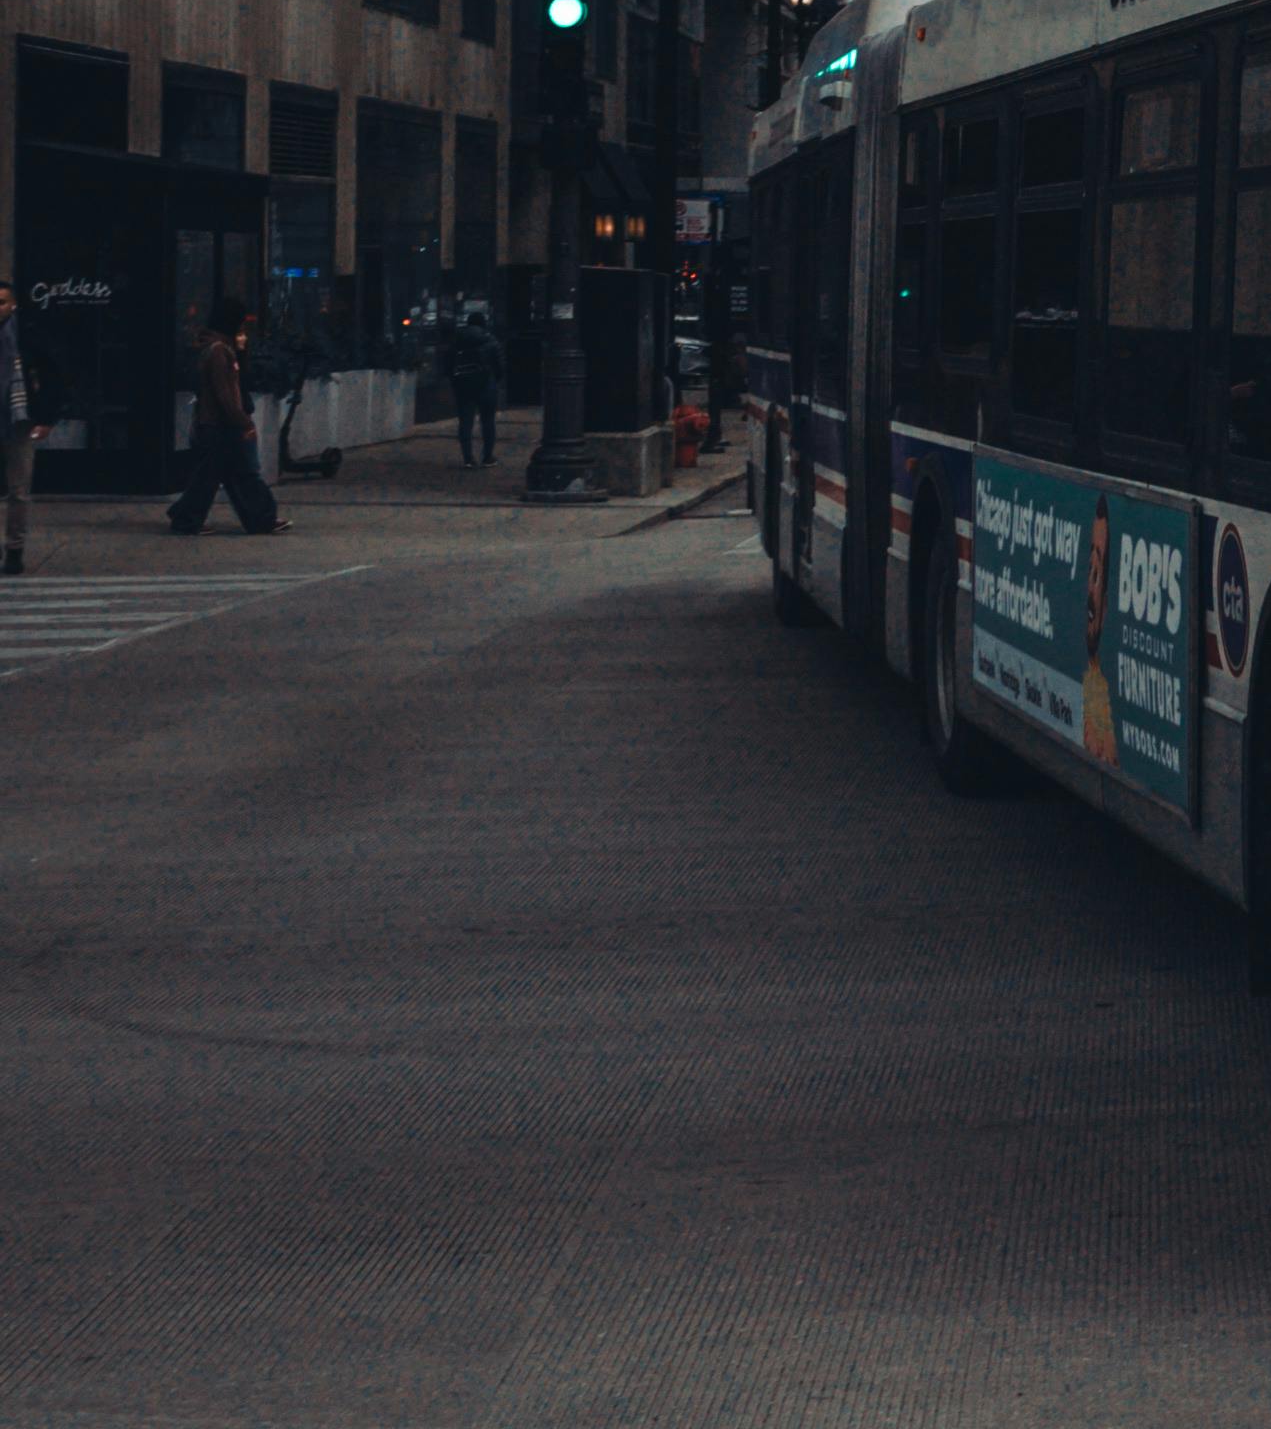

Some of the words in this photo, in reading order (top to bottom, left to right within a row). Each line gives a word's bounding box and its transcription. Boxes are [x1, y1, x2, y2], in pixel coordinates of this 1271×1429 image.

[976, 479, 1011, 552] Chicago
[1010, 488, 1034, 556] just
[1033, 505, 1055, 566] got
[1055, 519, 1082, 580] way
[975, 565, 995, 611] more
[995, 566, 1054, 640] affordable.
[1118, 532, 1182, 635] BOB'S
[1223, 576, 1244, 623] cta
[1122, 625, 1175, 665] DISCOUNT
[1118, 652, 1182, 727] FURNITURE
[1122, 720, 1180, 774] MYBOBS.COM
